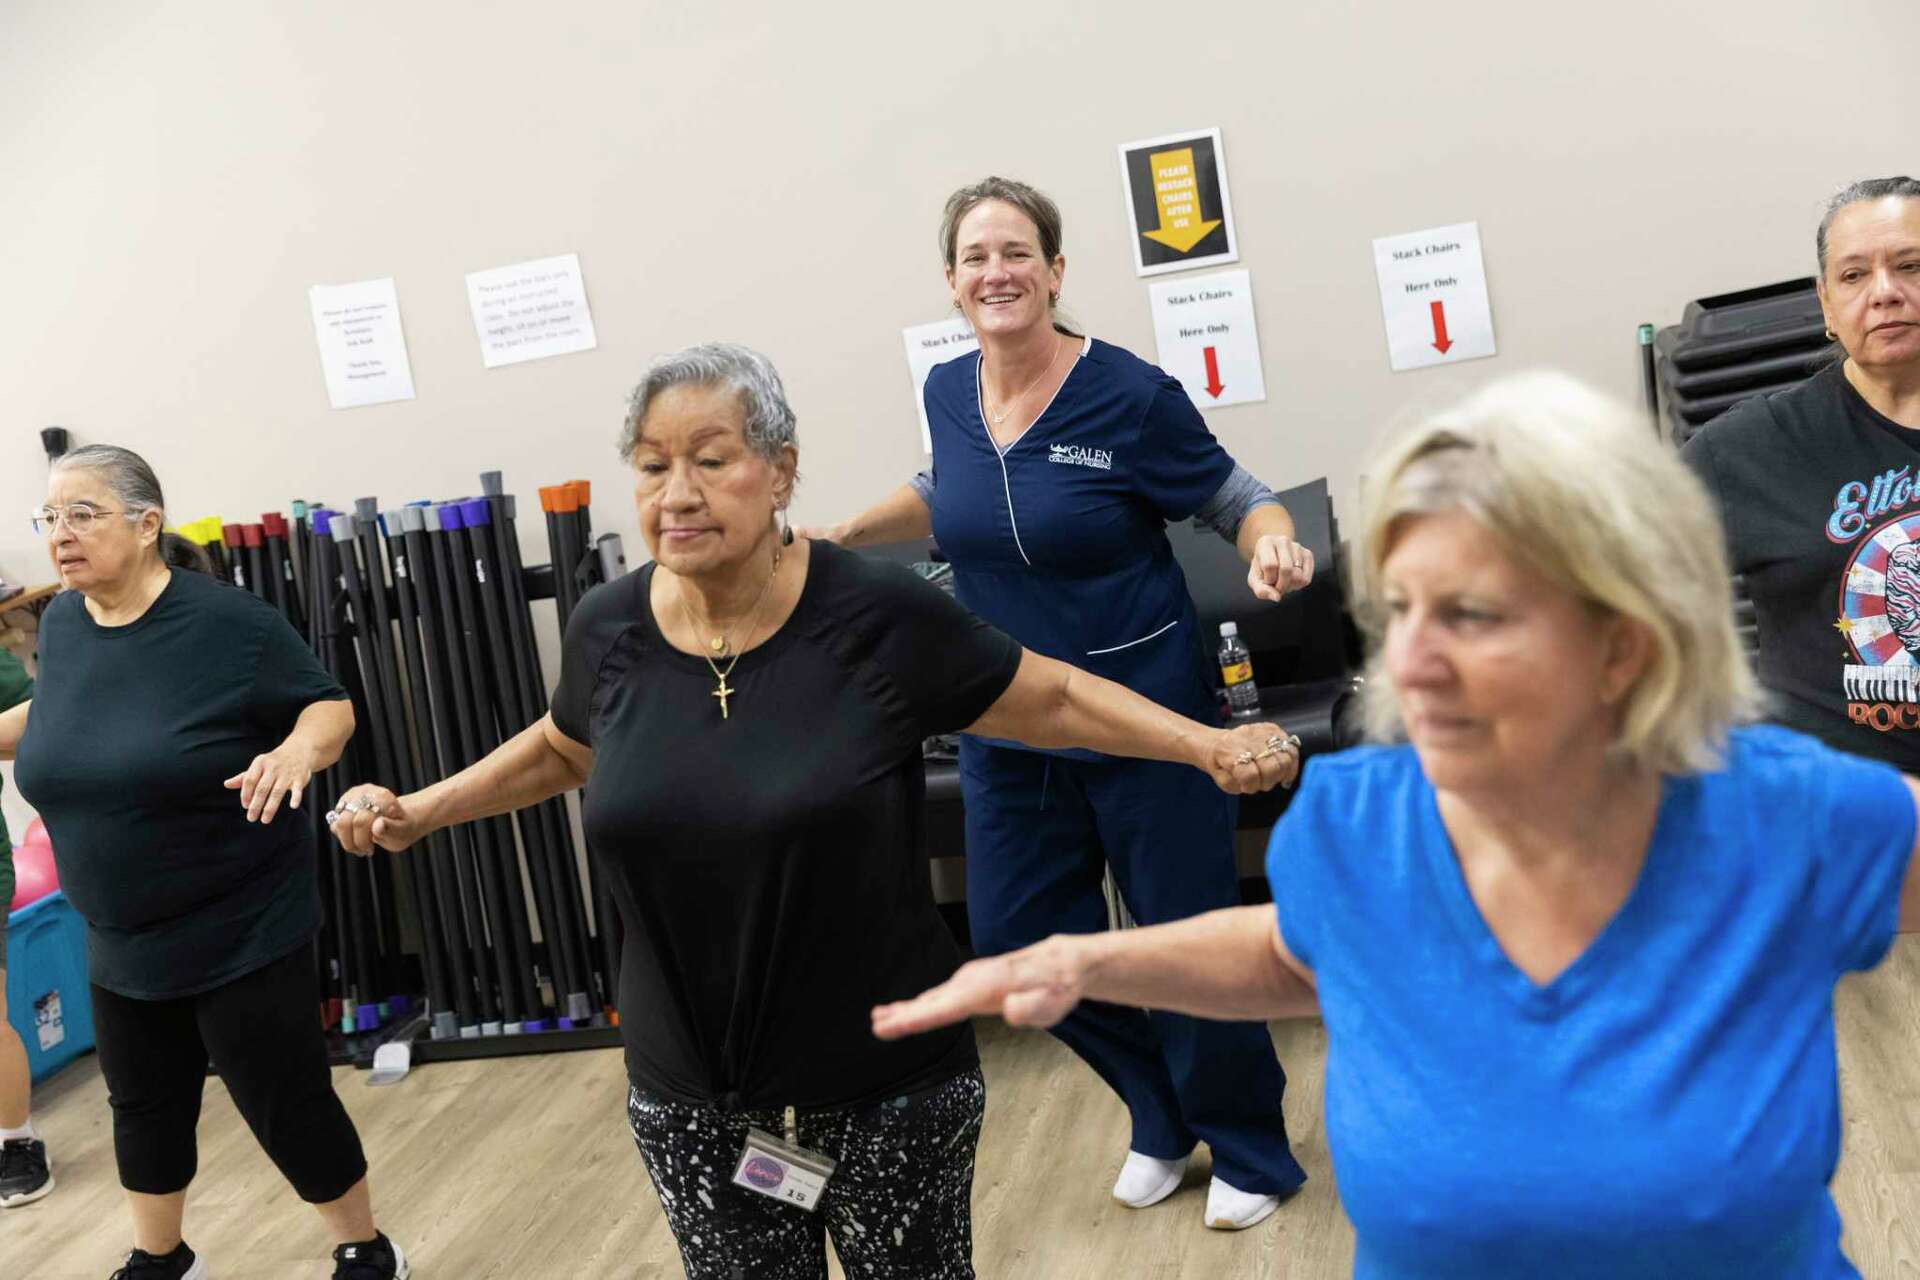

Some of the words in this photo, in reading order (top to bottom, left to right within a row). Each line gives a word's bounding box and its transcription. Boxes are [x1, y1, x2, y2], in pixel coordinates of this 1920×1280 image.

[1159, 165, 1189, 177] PLEASE
[1162, 192, 1192, 204] CHAIRS
[1166, 204, 1192, 216] AFTER
[1392, 248, 1422, 260] Stack
[1425, 241, 1461, 255] Chairs
[1405, 281, 1430, 293] Here
[1434, 276, 1458, 288] Only
[1167, 294, 1196, 305] Stack
[1199, 289, 1233, 301] Chairs
[1179, 327, 1203, 338] Here
[1207, 323, 1230, 335] Only
[922, 336, 949, 347] Stack
[1048, 454, 1074, 464] COLLEGE
[1068, 445, 1113, 463] GALEN
[1848, 703, 1920, 731] ROC
[786, 1189, 807, 1201] 15
